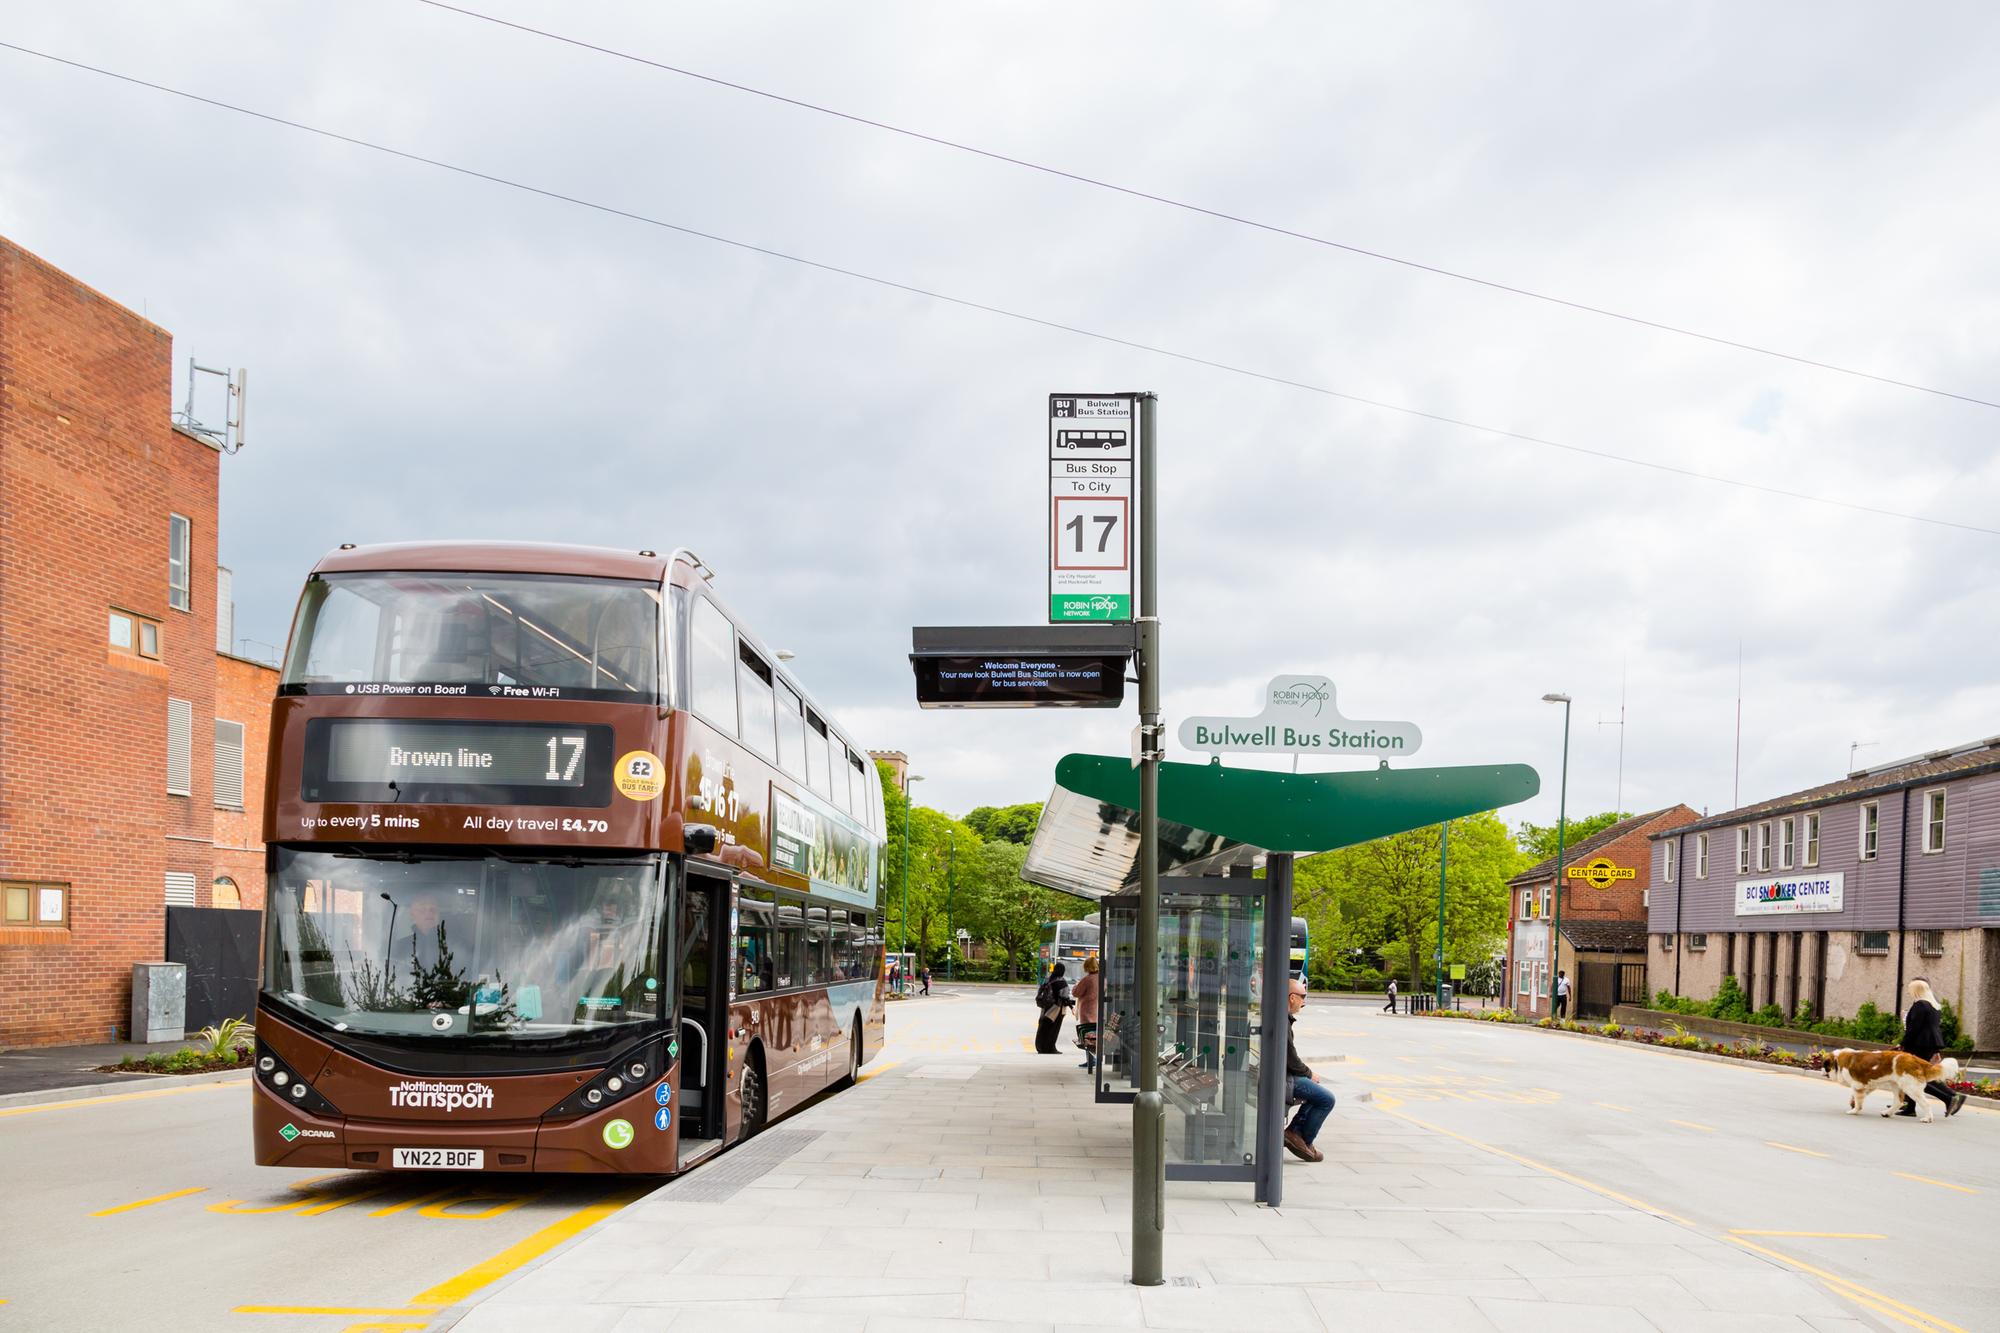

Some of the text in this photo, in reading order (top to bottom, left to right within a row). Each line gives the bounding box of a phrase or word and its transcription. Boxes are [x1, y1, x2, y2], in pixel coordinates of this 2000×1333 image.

[1066, 464, 1117, 475] Bus Stop
[1072, 482, 1111, 493] To City
[1066, 514, 1118, 552] 17
[1063, 601, 1118, 610] ROBIN HOOD
[1021, 662, 1056, 670] Everyone
[358, 685, 380, 693] USB
[382, 685, 416, 694] Power
[434, 685, 466, 694] Board
[504, 687, 560, 697] Free Wi-Fi
[1273, 690, 1329, 700] ROBIN HOOD
[1196, 725, 1404, 749] Bulwell Bus Station
[390, 746, 493, 768] Brown line
[545, 736, 585, 780] 17
[632, 761, 651, 776] £2
[638, 784, 659, 793] FARES
[699, 776, 739, 823] 15 16 17
[301, 815, 420, 829] Up to every 5 mins
[464, 816, 609, 833] All day travel £4.70
[1746, 880, 1830, 899] BCI SNOOKER CENTRE
[400, 1082, 489, 1095] Nottingham City
[389, 1086, 494, 1112] Transport
[301, 1130, 336, 1138] SCANIA
[401, 1151, 477, 1167] YN22 BOF
